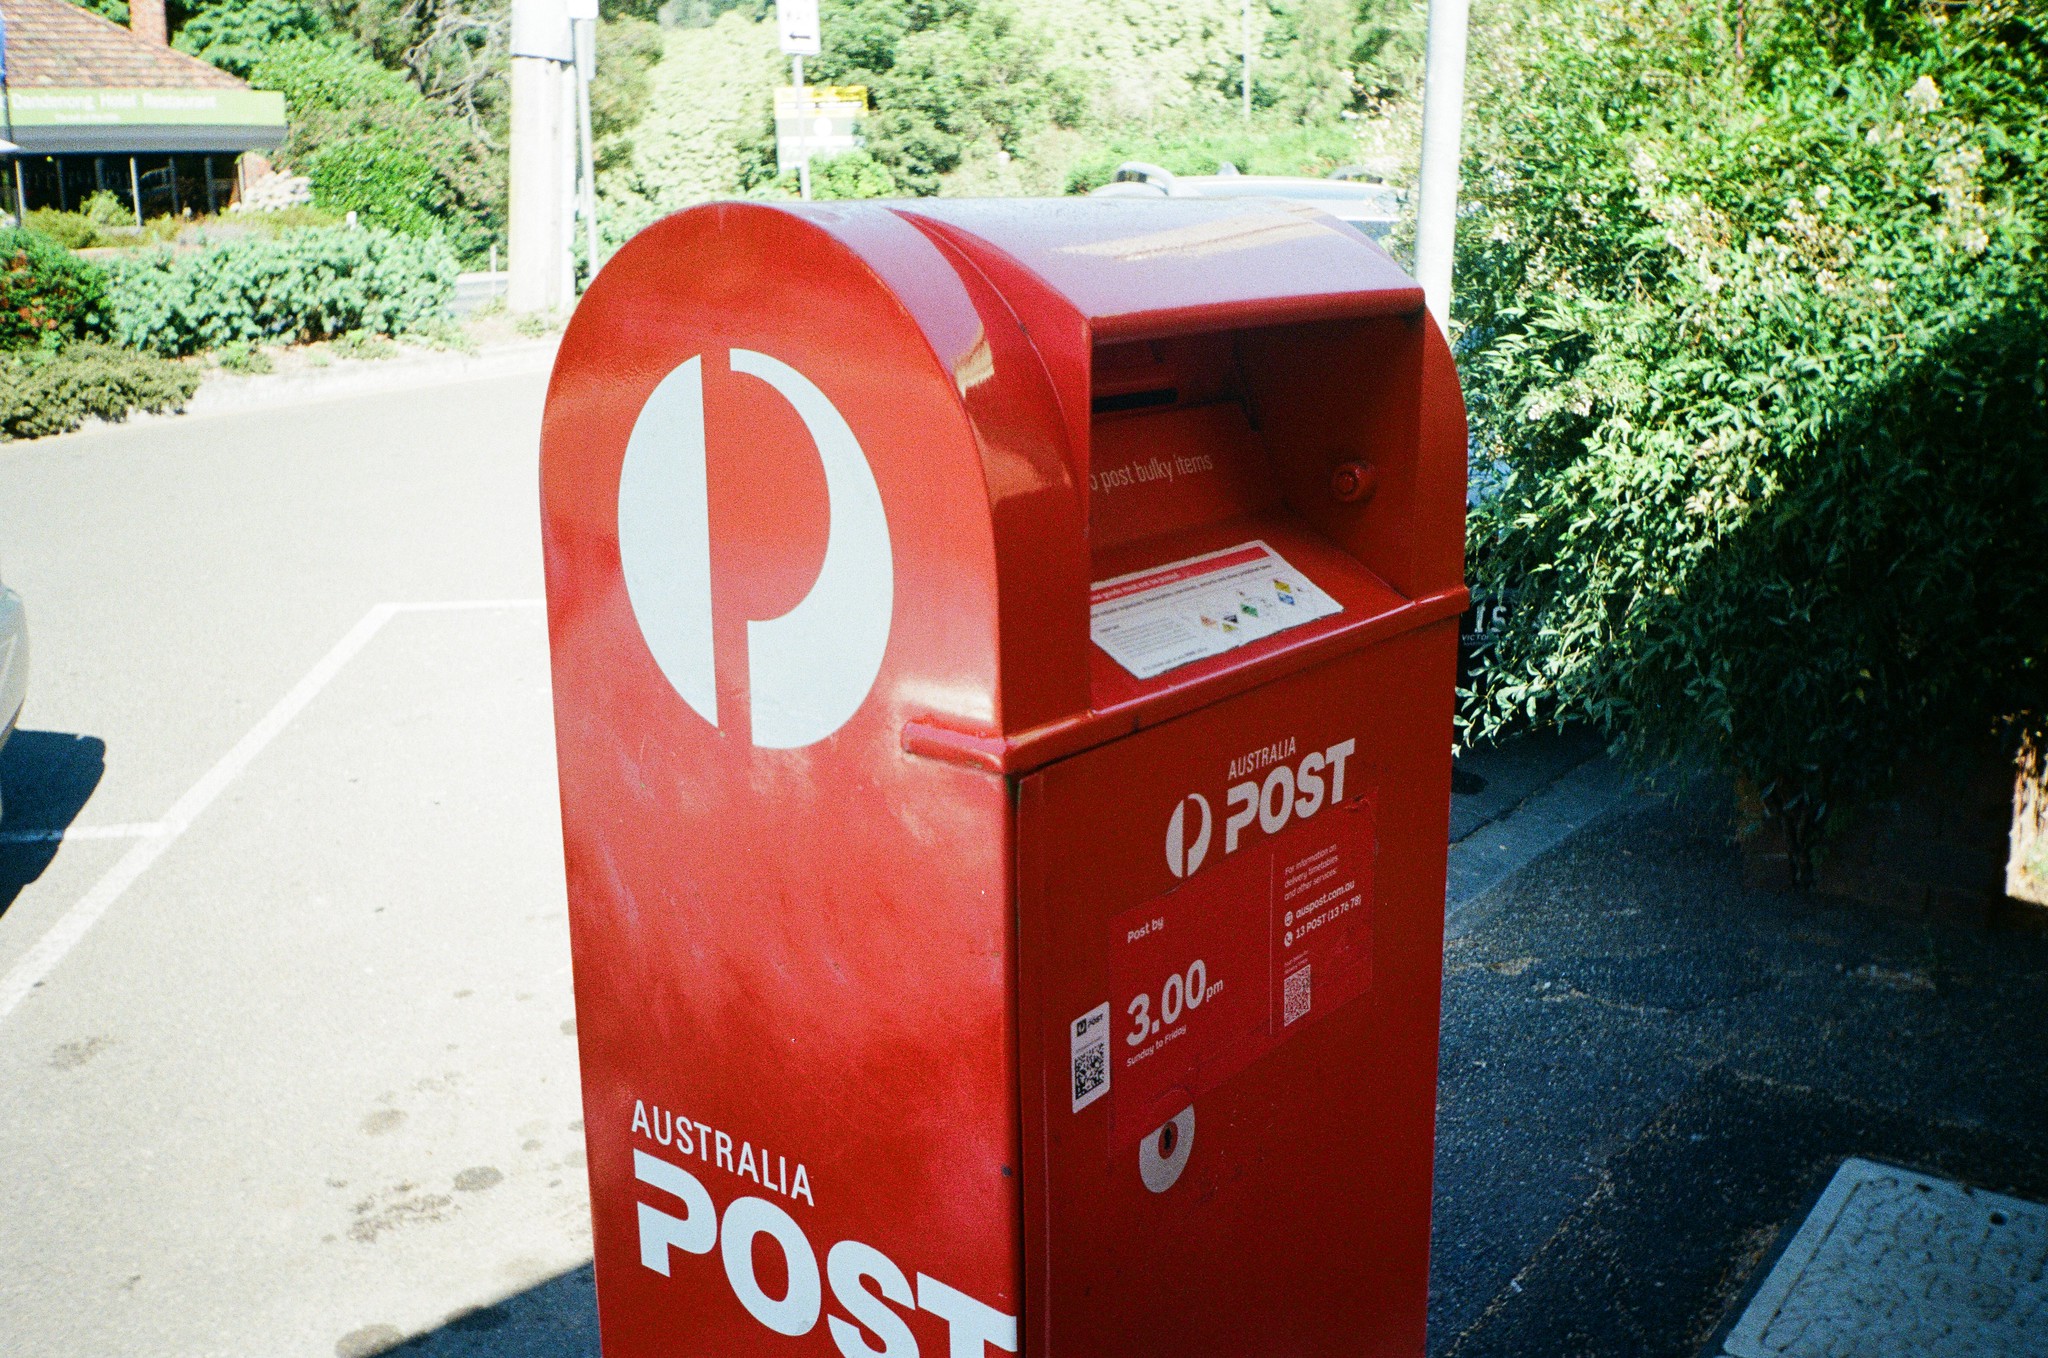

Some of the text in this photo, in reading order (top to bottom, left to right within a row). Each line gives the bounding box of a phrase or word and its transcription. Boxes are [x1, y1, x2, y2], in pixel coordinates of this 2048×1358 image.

[1100, 464, 1135, 495] post
[1133, 457, 1173, 482] bulky
[1172, 454, 1213, 475] items
[1227, 736, 1297, 781] AUSTRALIA
[1225, 738, 1356, 854] POST
[1284, 871, 1308, 889] delivery
[1285, 865, 1295, 876] For
[1295, 848, 1328, 870] information
[1284, 887, 1297, 901] and
[1295, 879, 1355, 919] auspost.com.au
[1127, 916, 1165, 943] Post by
[1295, 893, 1362, 939] 13 POST (13 76 78)
[1126, 1044, 1155, 1068] Sunday
[1155, 1038, 1164, 1050] to
[1164, 1024, 1187, 1047] Friday
[631, 1100, 815, 1208] AUSTRALIA
[633, 1148, 1018, 1358] POST
